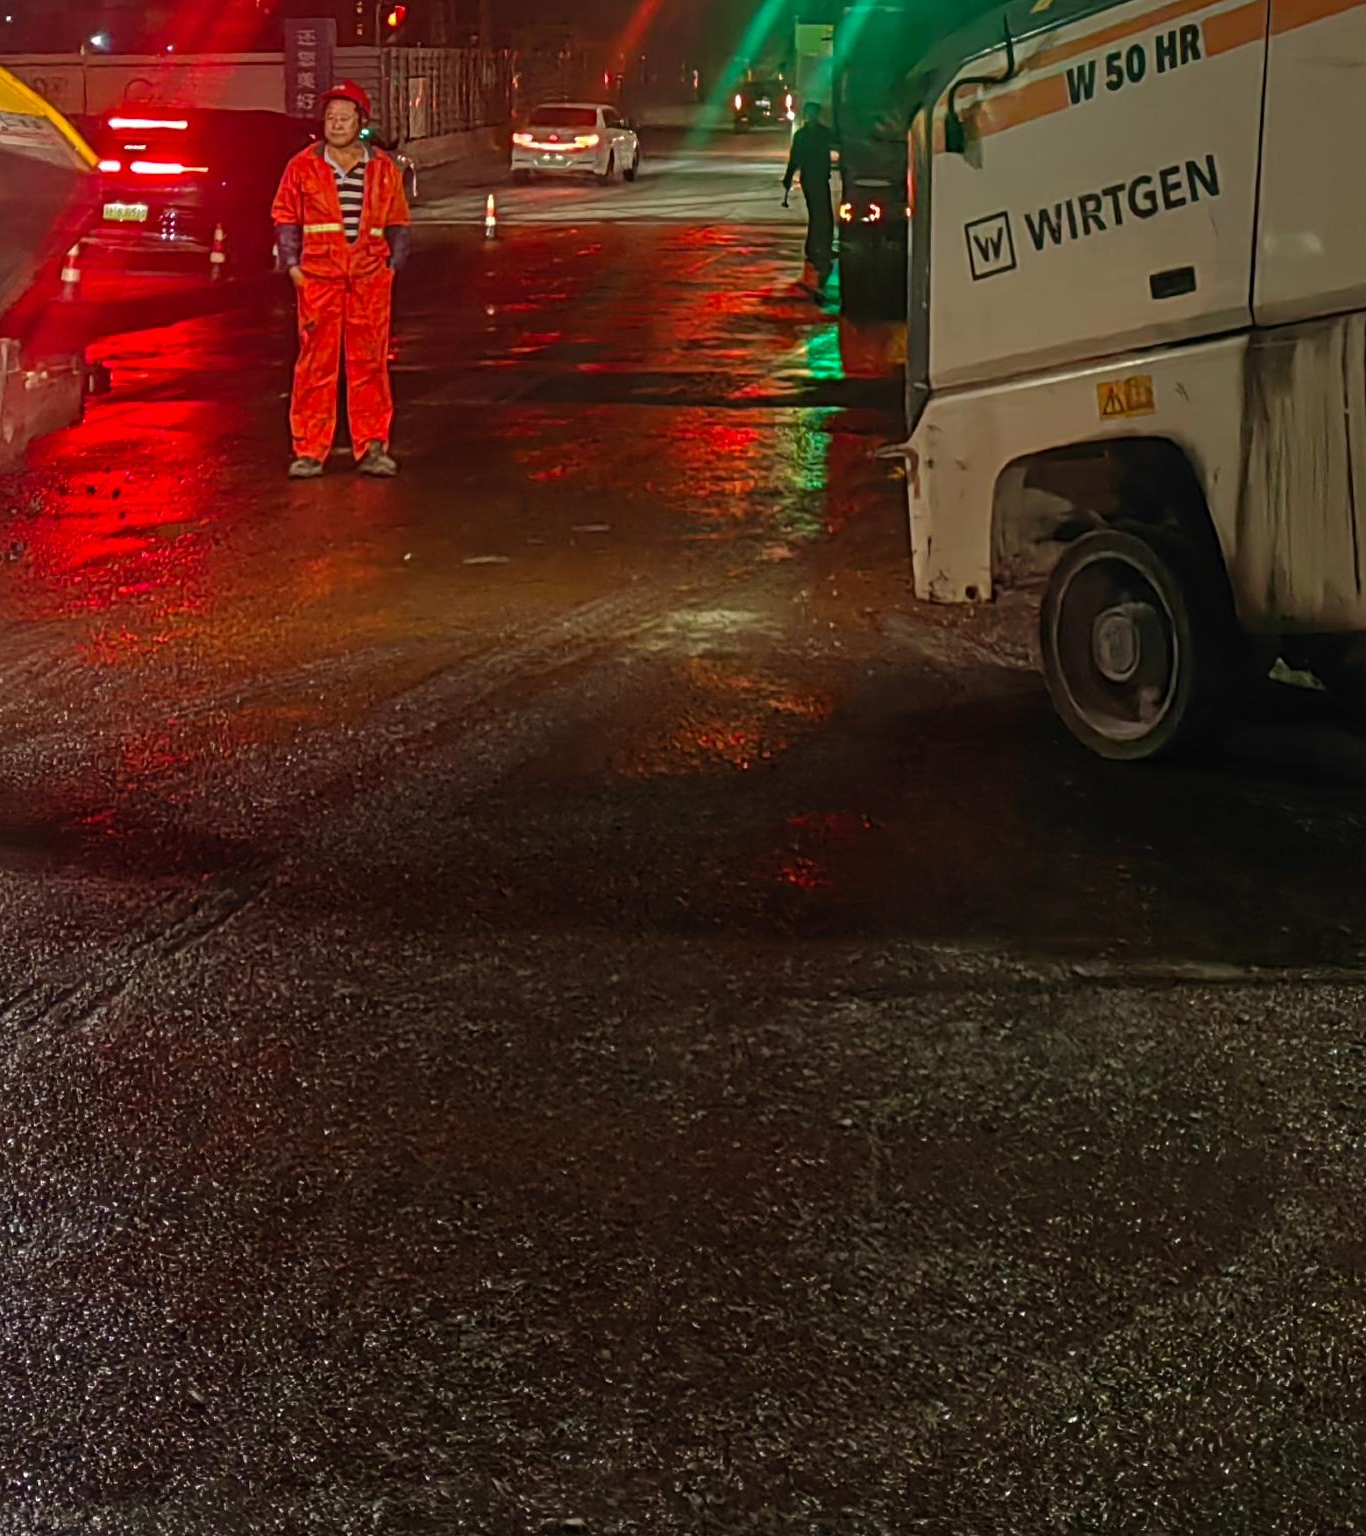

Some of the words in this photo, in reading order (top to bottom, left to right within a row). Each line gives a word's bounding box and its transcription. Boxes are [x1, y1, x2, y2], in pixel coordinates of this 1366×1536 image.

[1066, 60, 1096, 105] W
[1105, 44, 1146, 91] 50
[1155, 24, 1201, 73] HR
[1024, 154, 1220, 250] WIRTGEN
